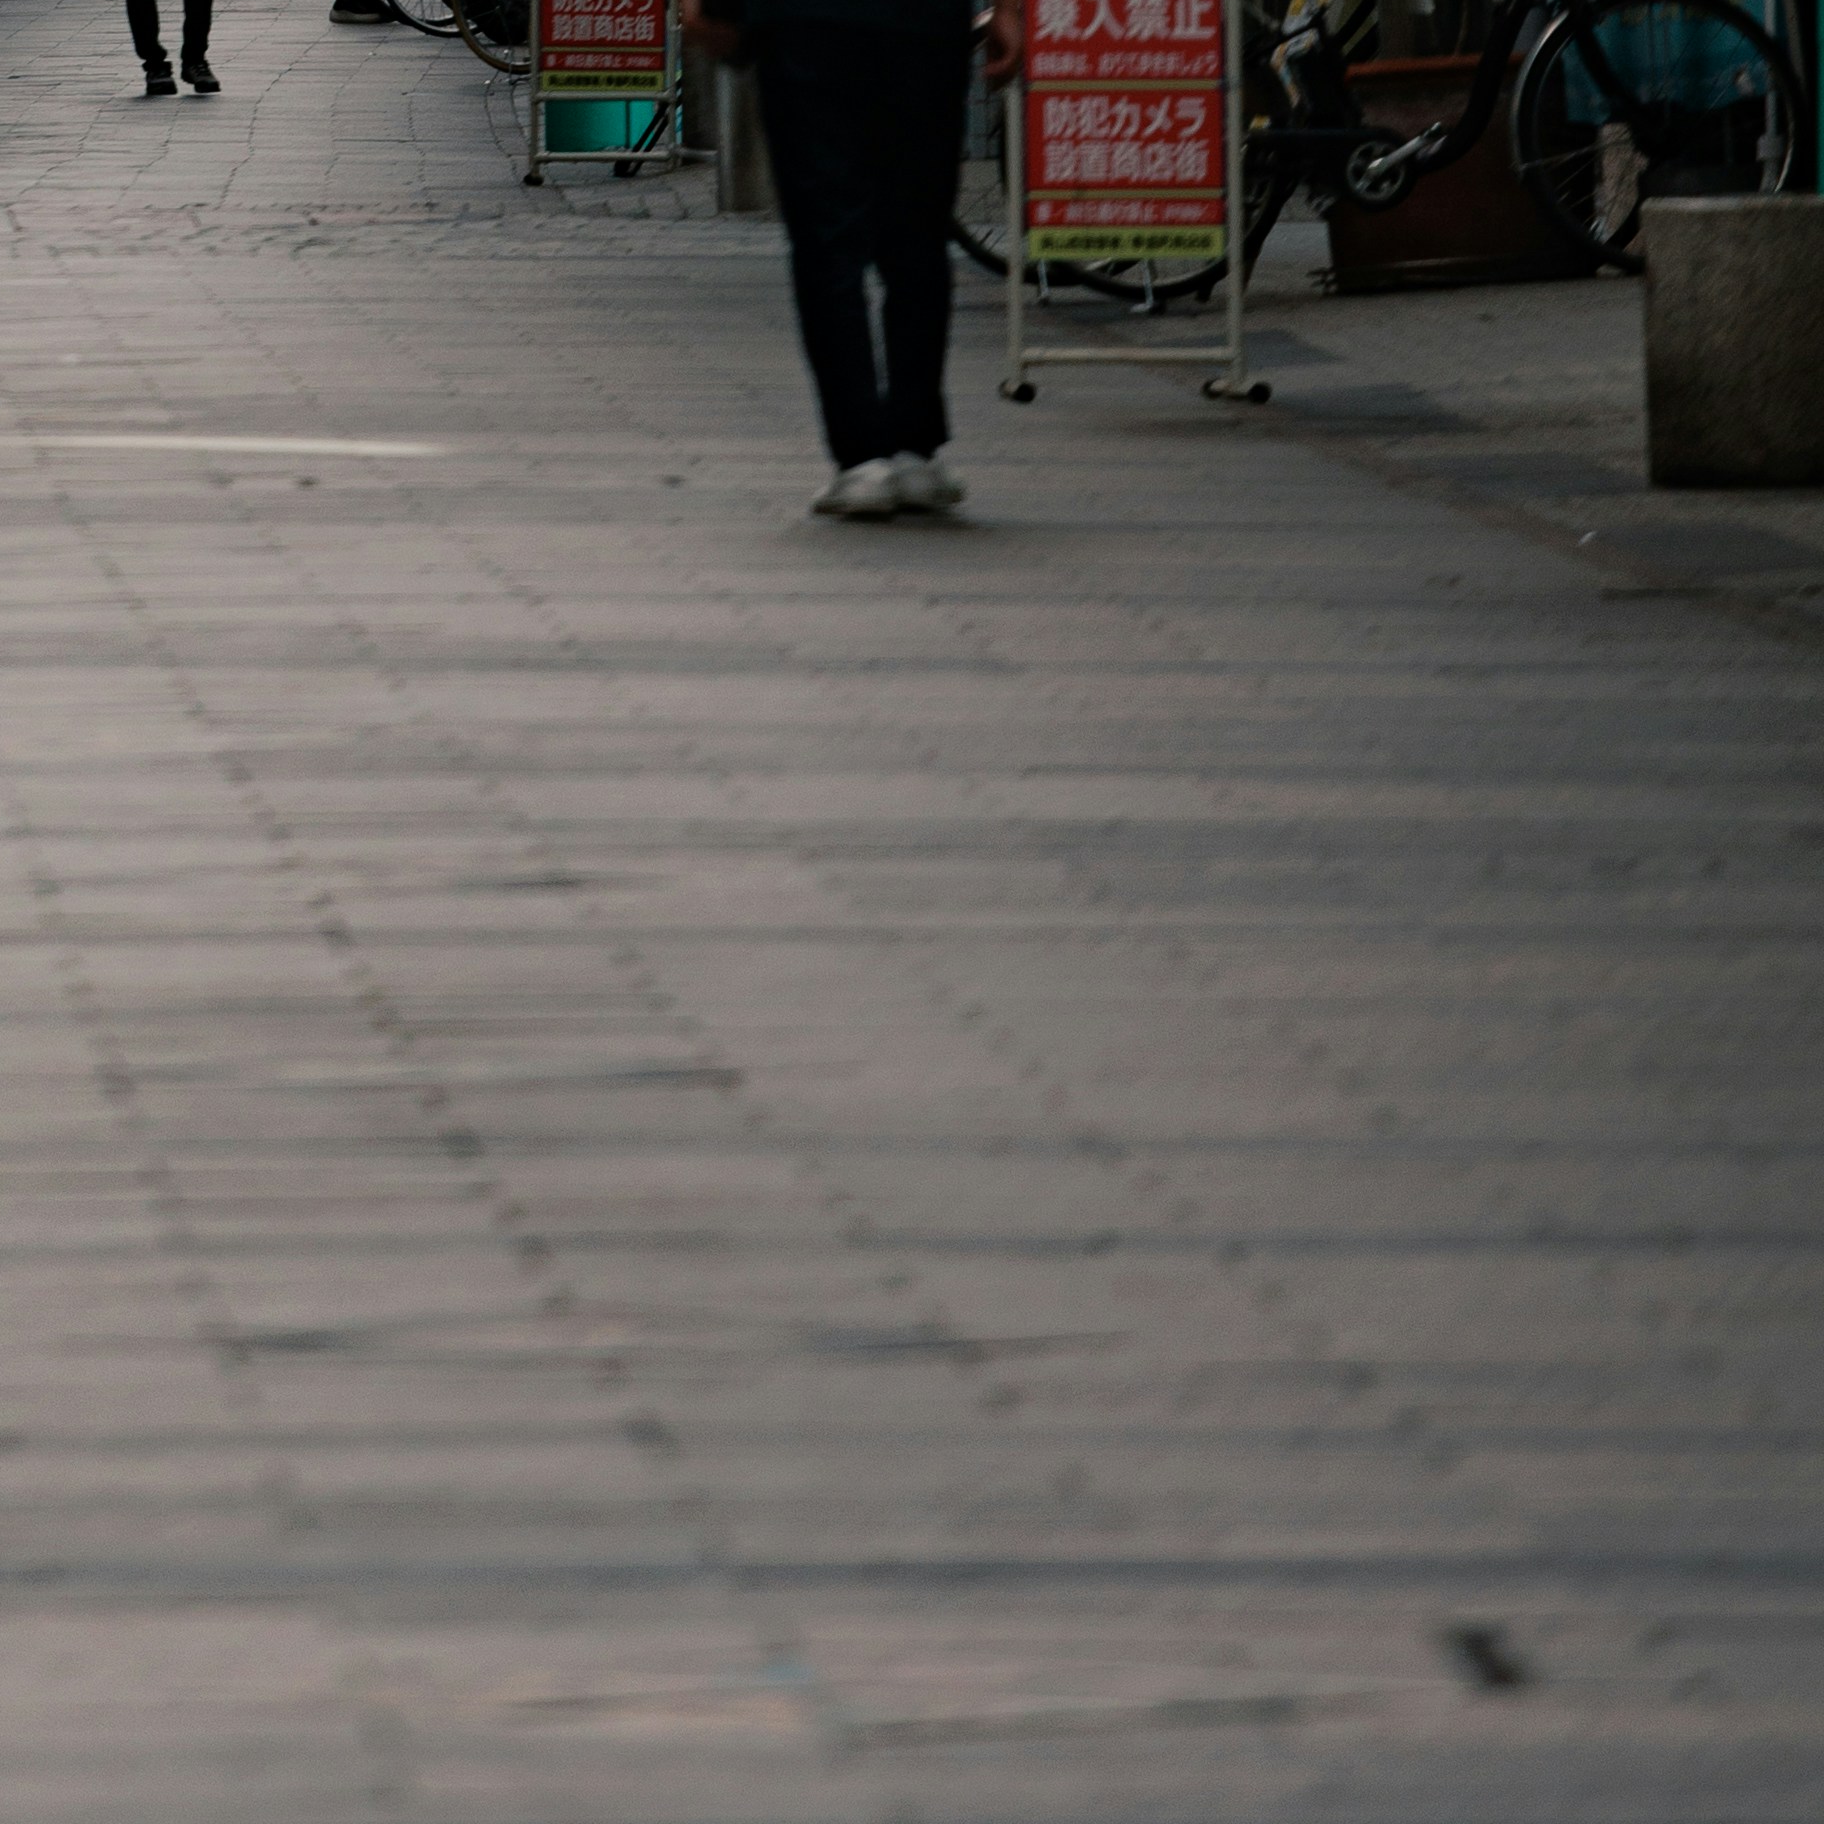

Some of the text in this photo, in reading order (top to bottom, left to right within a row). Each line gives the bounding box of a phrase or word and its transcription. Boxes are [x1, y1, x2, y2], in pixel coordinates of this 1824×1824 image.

[551, 15, 656, 43] 設置商店街
[1042, 95, 1208, 140] 防犯カメラ
[1043, 140, 1210, 183] 設置商店街
